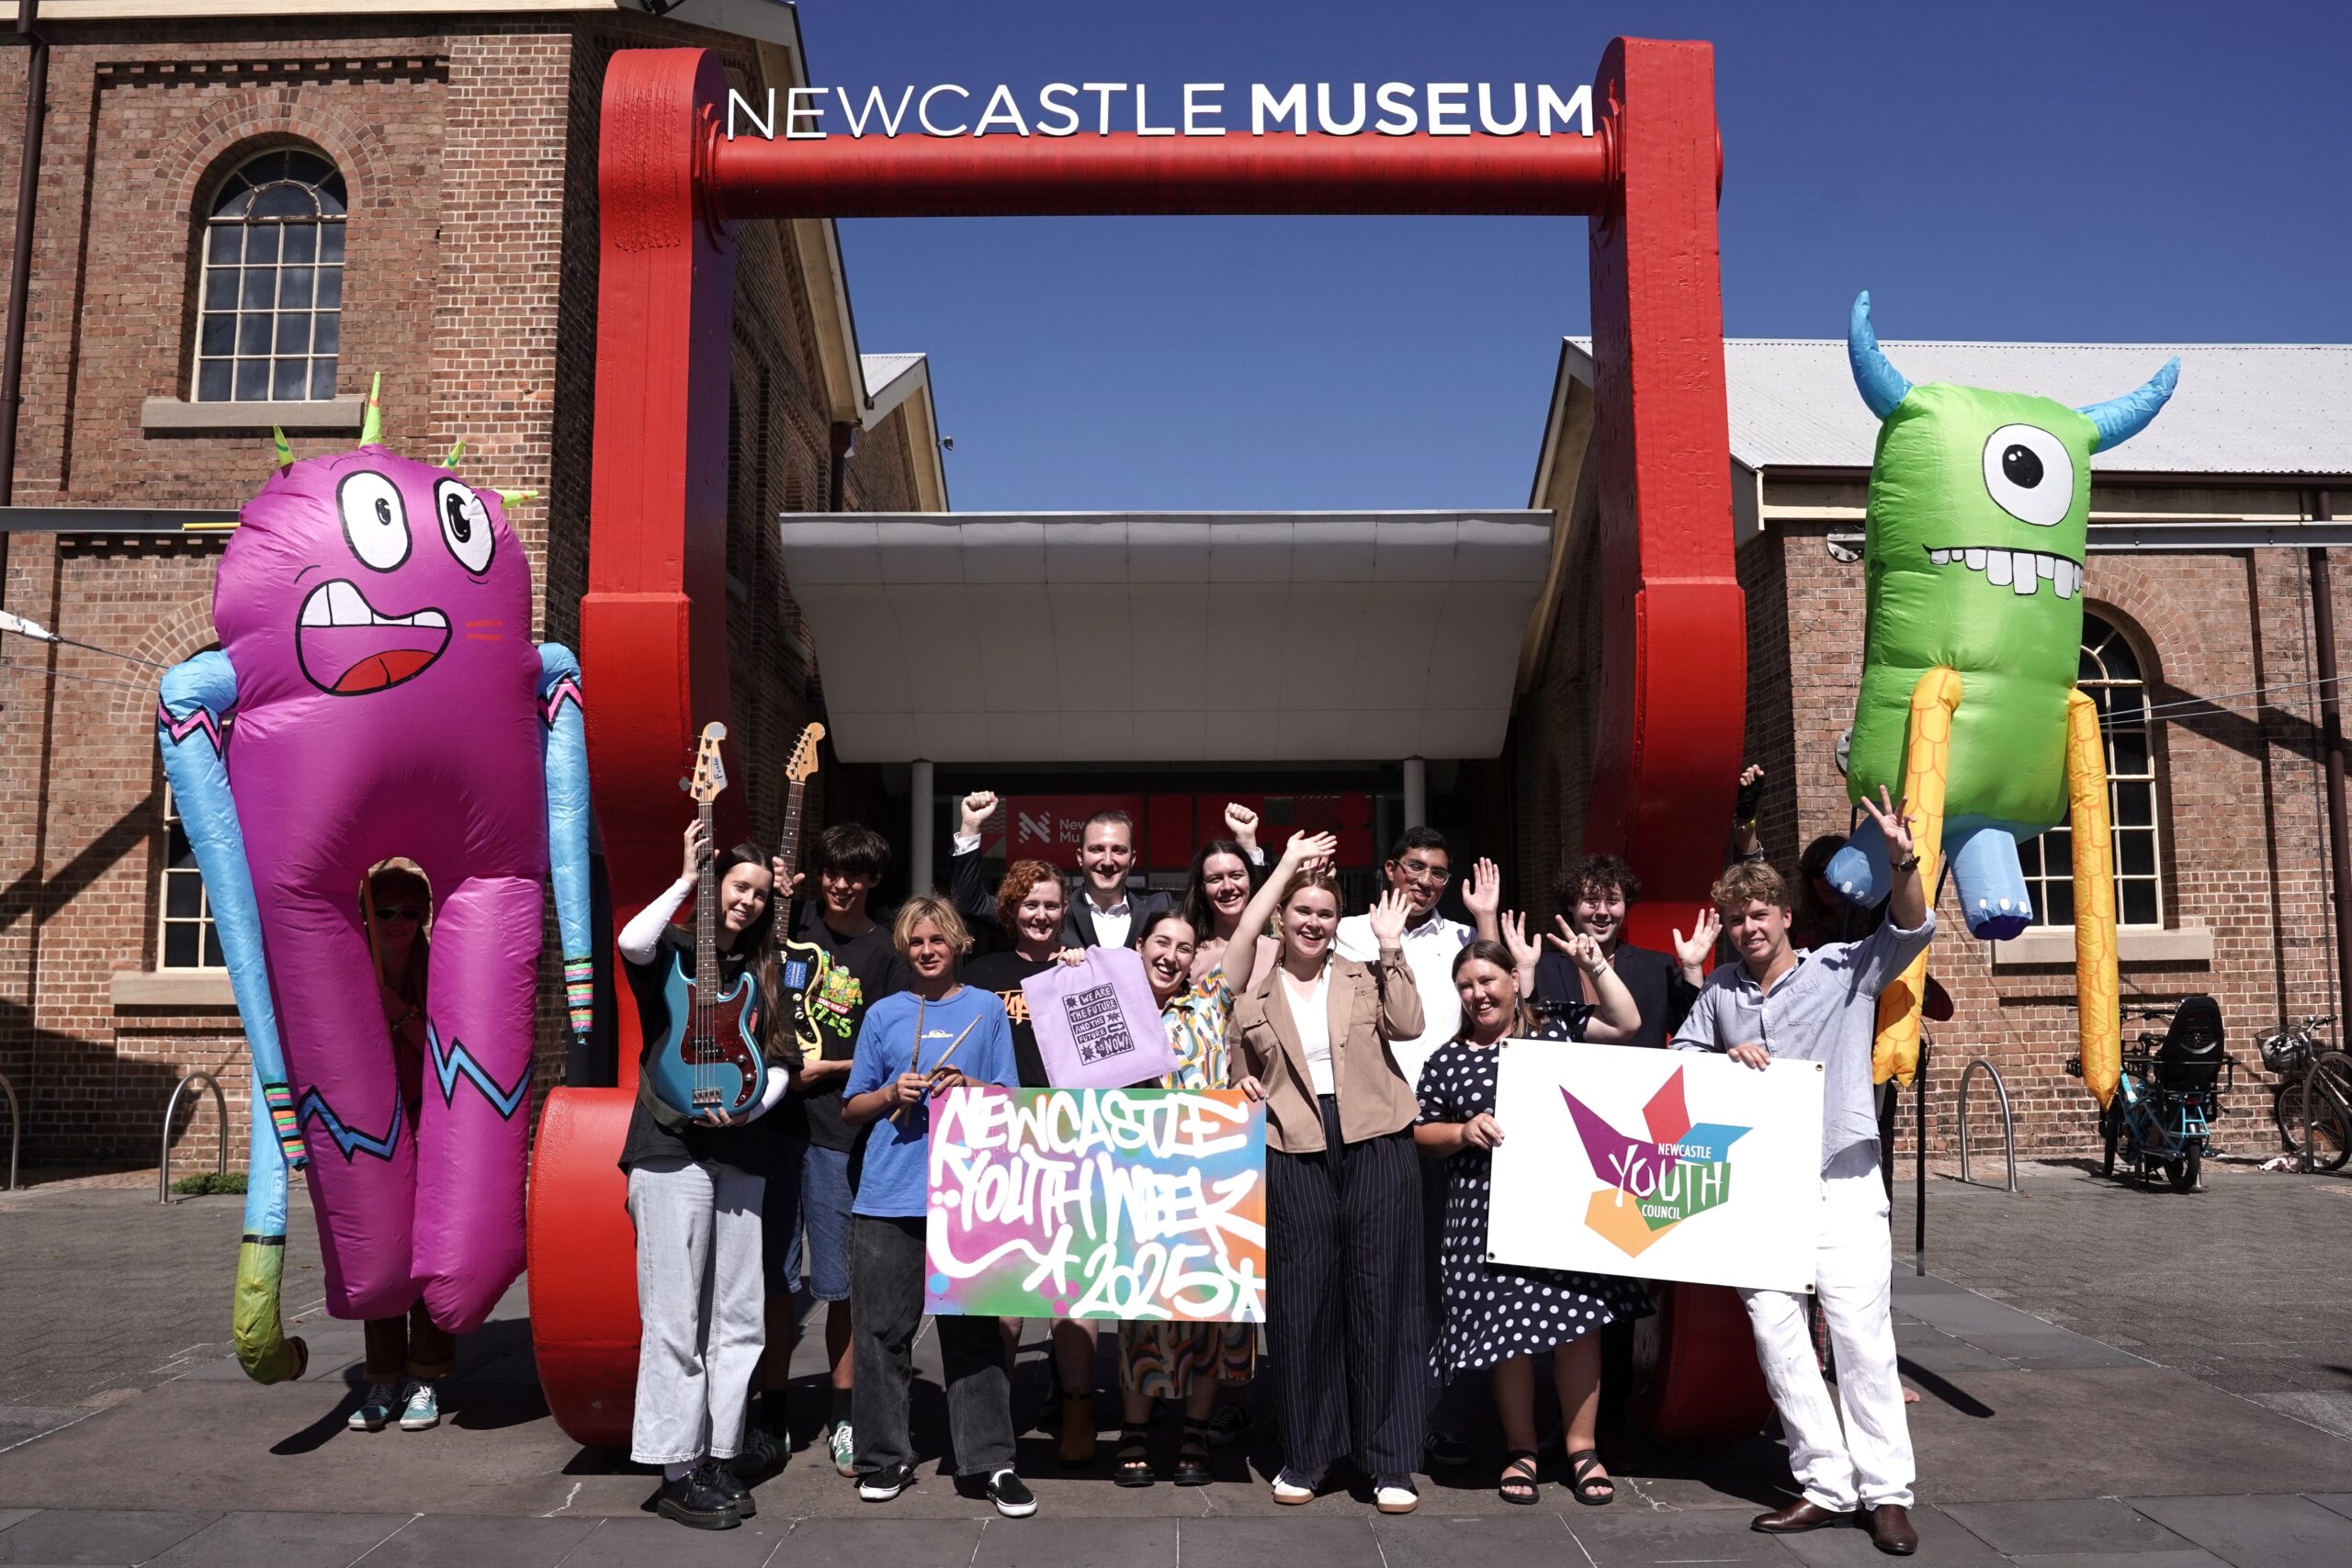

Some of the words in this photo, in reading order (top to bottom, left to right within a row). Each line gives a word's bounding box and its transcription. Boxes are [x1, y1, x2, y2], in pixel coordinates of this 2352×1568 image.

[728, 83, 1226, 140] NEWCASTLE
[1252, 82, 1594, 137] MUSEUM
[1080, 993, 1094, 1004] WE
[1094, 987, 1112, 999] ARE
[1070, 1010, 1087, 1022] THE
[1087, 999, 1116, 1016] FUTURE
[1075, 1023, 1091, 1034] AND
[1090, 1016, 1104, 1026] THE
[1079, 1028, 1105, 1043] FUTURE
[1104, 1034, 1129, 1054] NOW!
[932, 1087, 1250, 1161] NEWCASTLE
[1658, 1143, 1712, 1159] NEWCASTLE
[1608, 1144, 1724, 1214] YOUTH
[941, 1144, 1097, 1240] YOUTH
[1097, 1151, 1266, 1248] WEEK
[1642, 1204, 1682, 1220] COUNCIL
[1069, 1242, 1235, 1319] 2025
